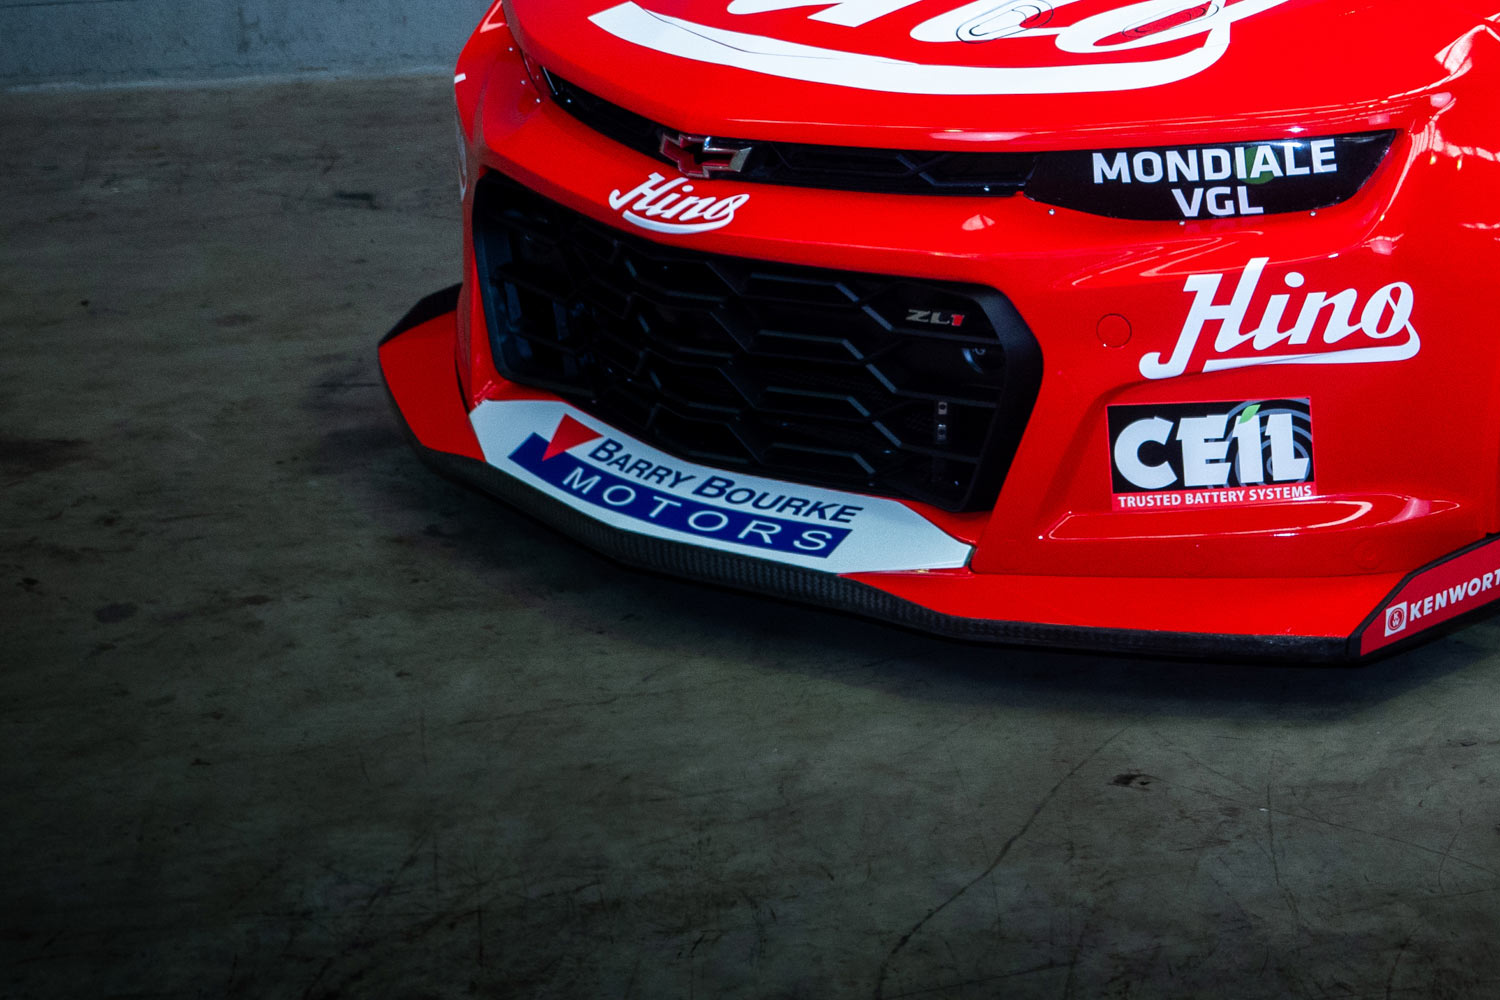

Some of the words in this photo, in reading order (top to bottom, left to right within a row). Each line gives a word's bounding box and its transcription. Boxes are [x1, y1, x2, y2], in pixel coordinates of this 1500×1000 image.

[1092, 139, 1338, 184] MONDIALE
[608, 171, 750, 234] Hino
[1172, 185, 1264, 218] VGL
[905, 308, 965, 327] ZL1
[1139, 257, 1421, 380] Hino
[1114, 404, 1310, 490] CEIL
[562, 466, 834, 552] MOTORS
[588, 437, 697, 489] BARRY
[692, 475, 864, 525] BOURKE
[1118, 493, 1181, 508] TRUSTED
[1185, 489, 1246, 505] BATTERY
[1249, 485, 1312, 501] SYSTEMS
